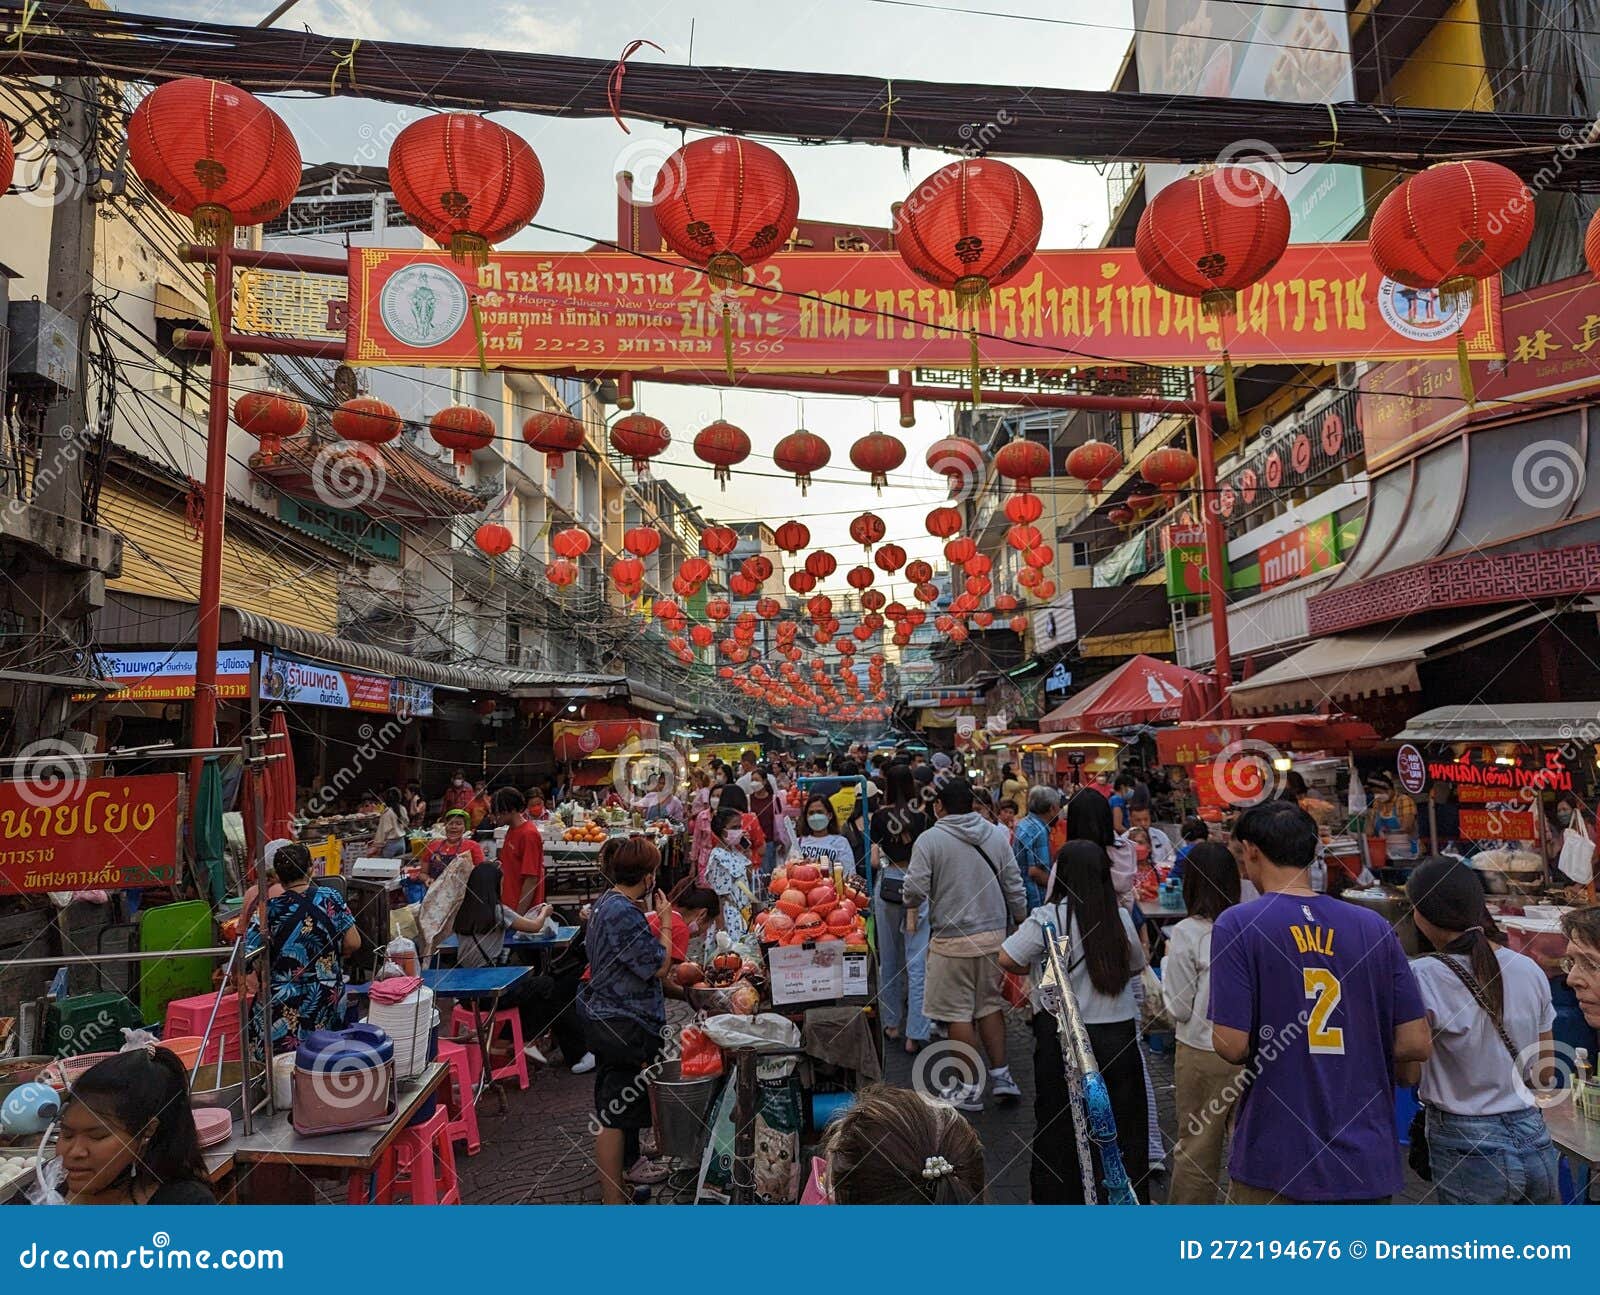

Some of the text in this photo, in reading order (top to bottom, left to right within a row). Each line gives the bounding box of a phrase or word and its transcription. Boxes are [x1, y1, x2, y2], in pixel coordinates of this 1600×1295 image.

[518, 294, 559, 307] Happy
[614, 297, 643, 310] New
[647, 298, 677, 312] Year
[533, 338, 606, 354] 22-23
[1264, 531, 1307, 585] mini
[0, 786, 156, 839] นายโย่ง
[799, 845, 837, 861] OSCHINO
[24, 860, 121, 888] พิเศษตามสั่ง
[1289, 924, 1335, 957] BALL
[1303, 967, 1346, 1055] 2
